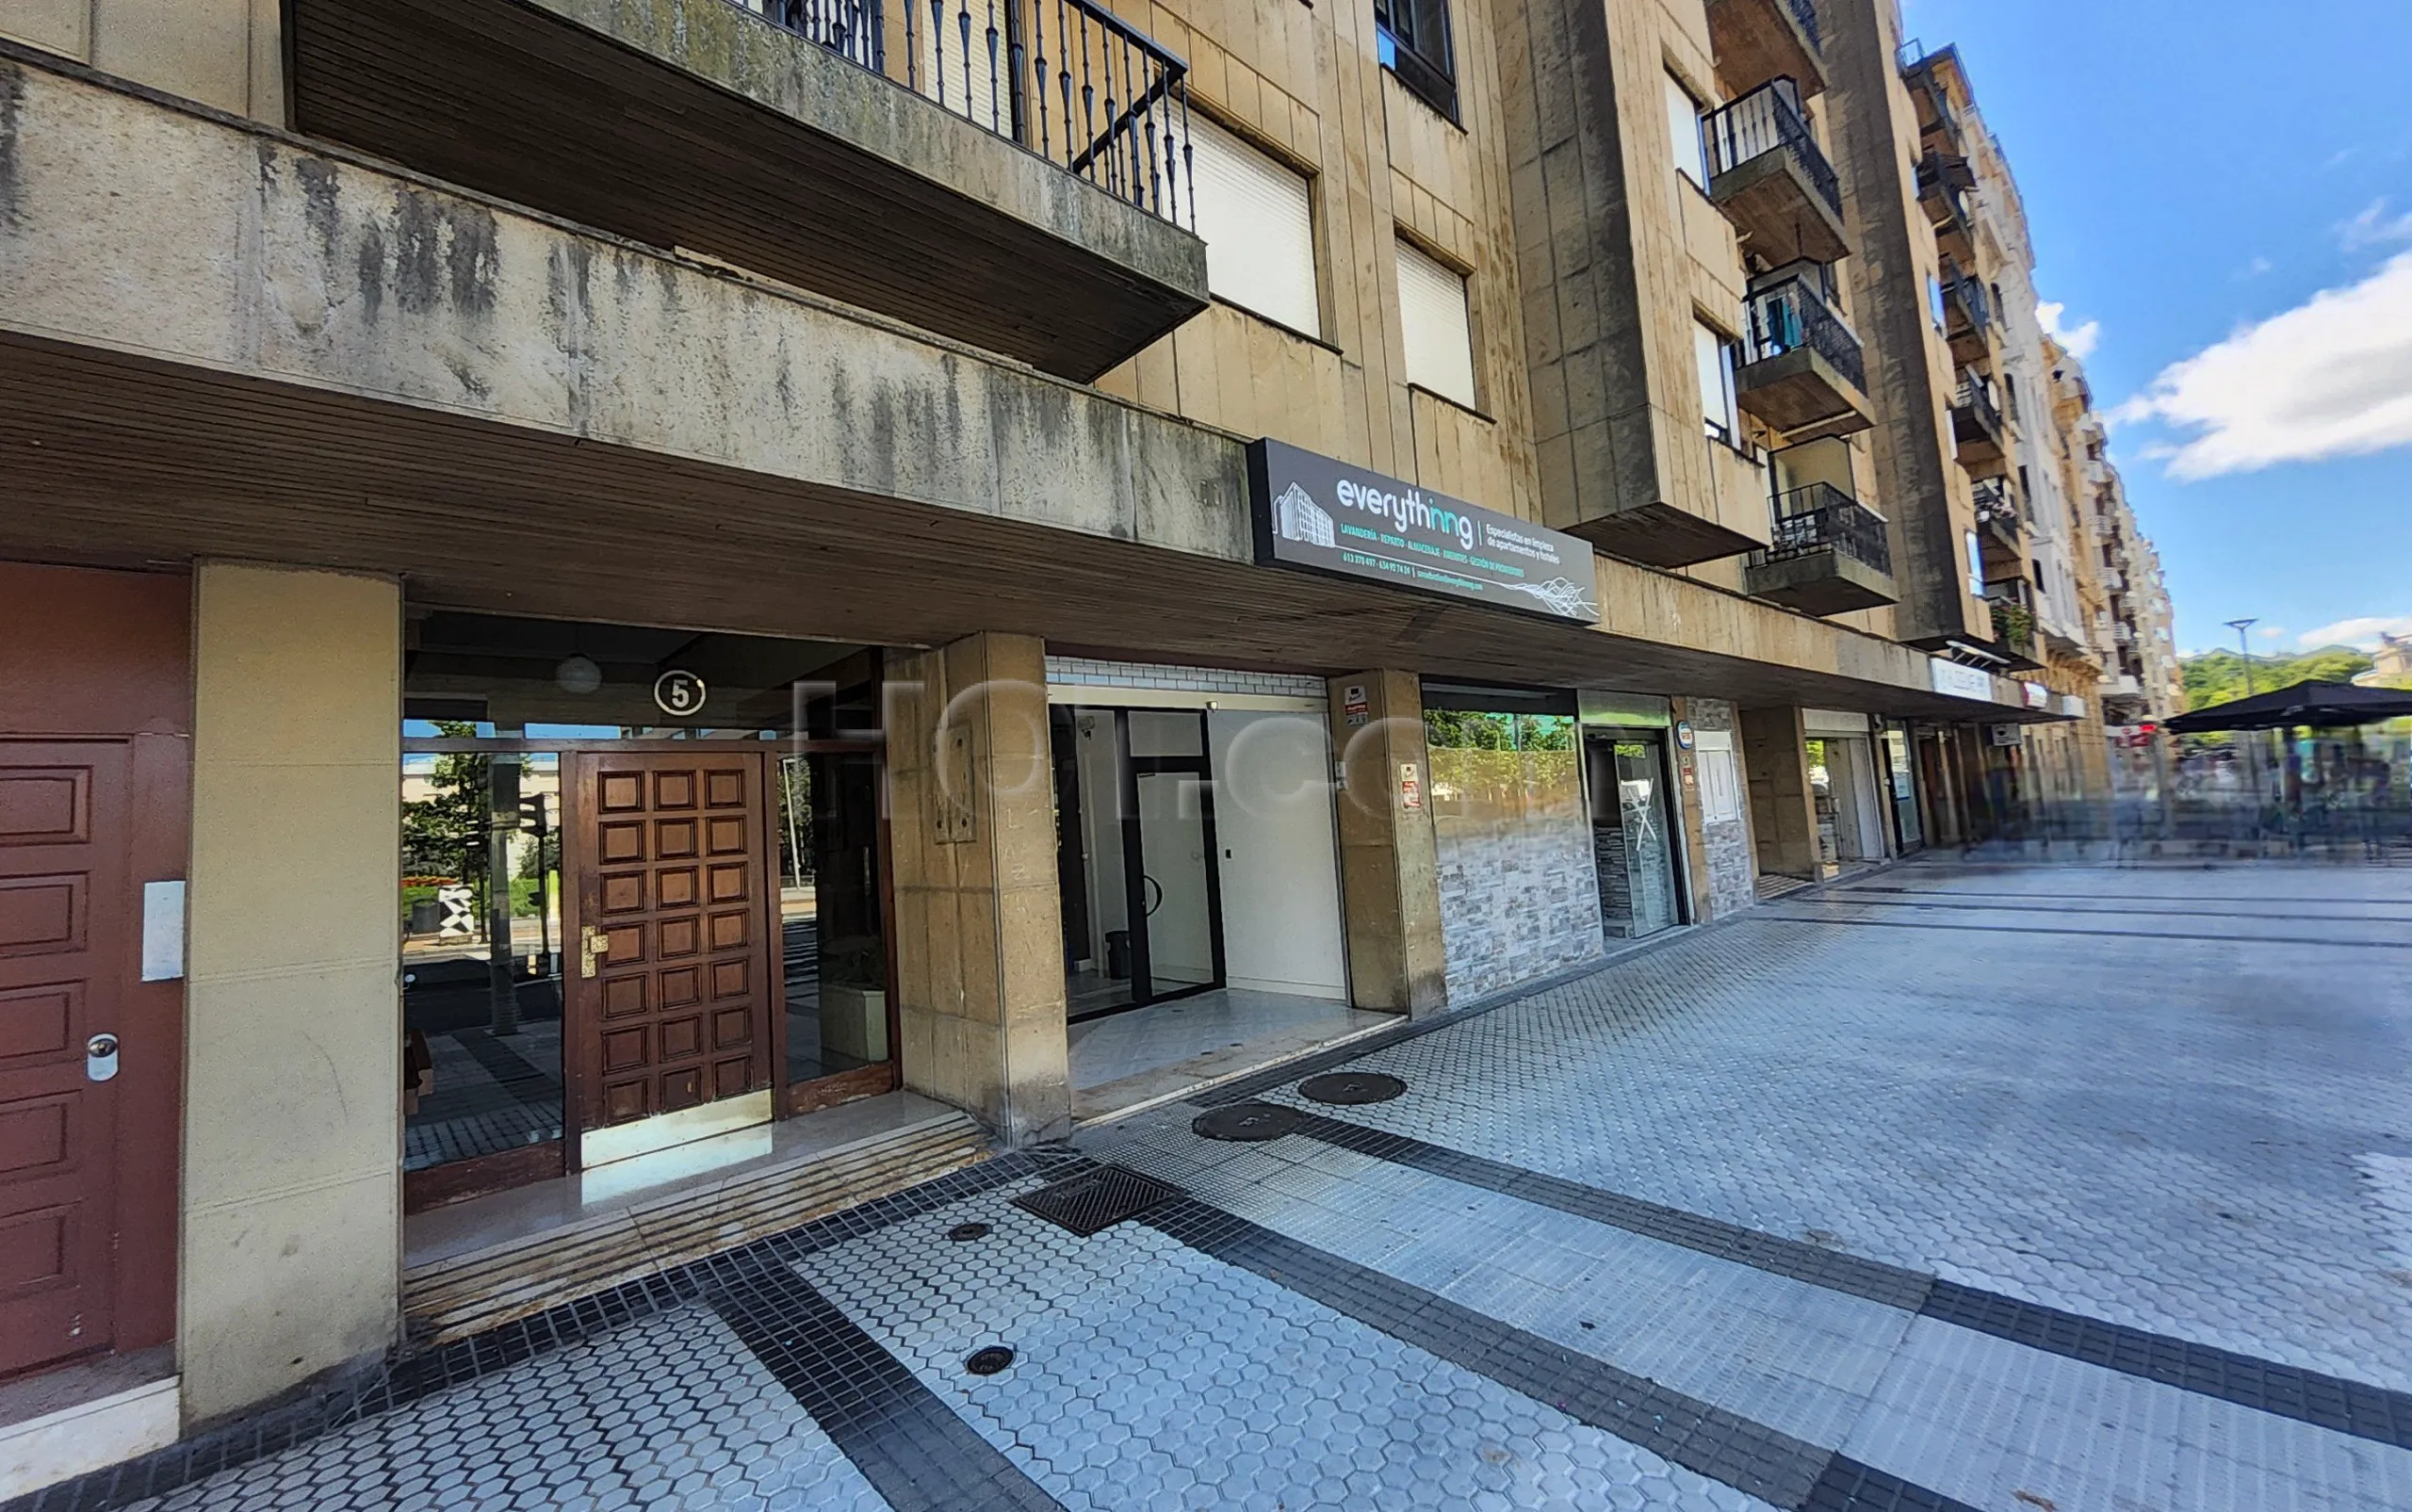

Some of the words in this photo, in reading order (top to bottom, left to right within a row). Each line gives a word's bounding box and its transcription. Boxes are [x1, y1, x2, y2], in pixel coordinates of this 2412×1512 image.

[1336, 479, 1474, 550] everythinng
[1340, 523, 1377, 542] LAVANDERÍA
[1380, 533, 1405, 548] REPARTO
[1486, 523, 1524, 544] Especialistas
[1524, 536, 1531, 545] en
[1487, 536, 1495, 546] de
[672, 679, 690, 708] 5
